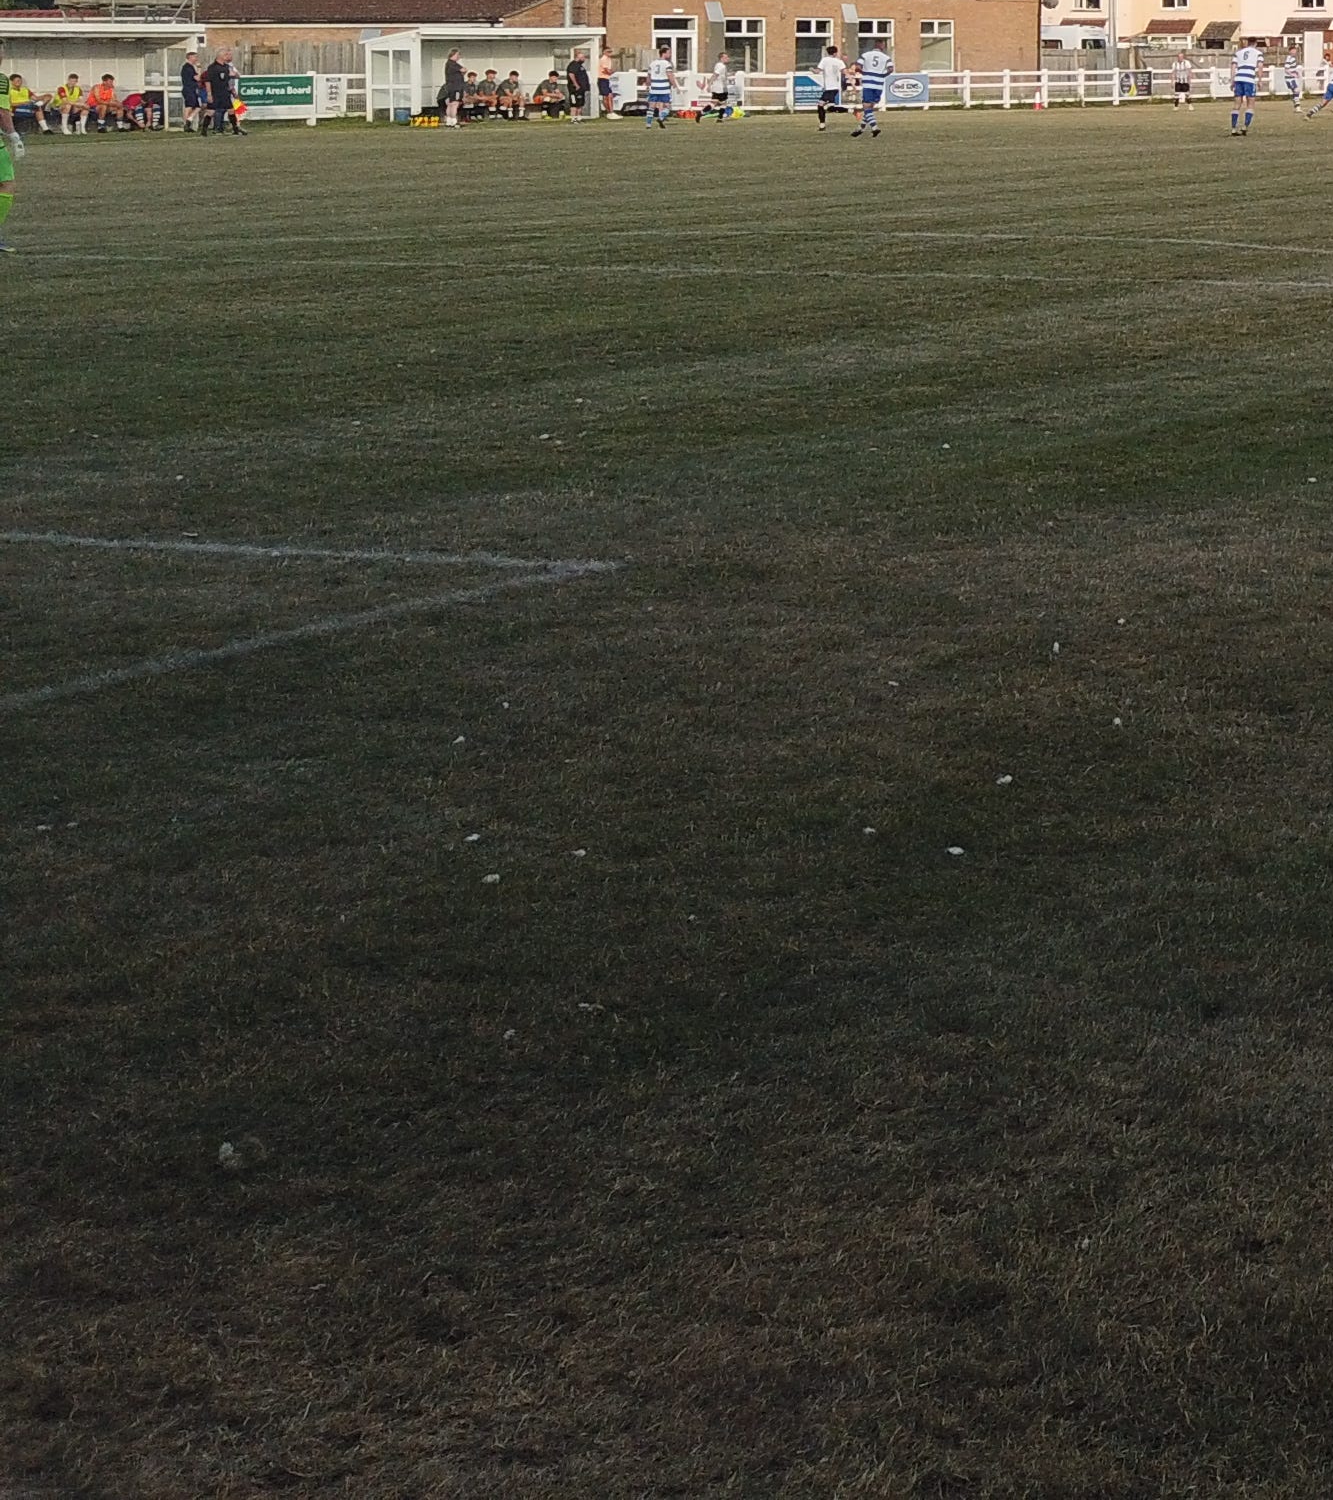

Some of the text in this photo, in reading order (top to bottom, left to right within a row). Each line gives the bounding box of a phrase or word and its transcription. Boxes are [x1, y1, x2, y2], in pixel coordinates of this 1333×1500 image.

[1243, 50, 1249, 60] 6
[872, 56, 879, 67] 5
[655, 65, 661, 74] 3
[265, 86, 285, 95] Area
[286, 85, 311, 95] Board
